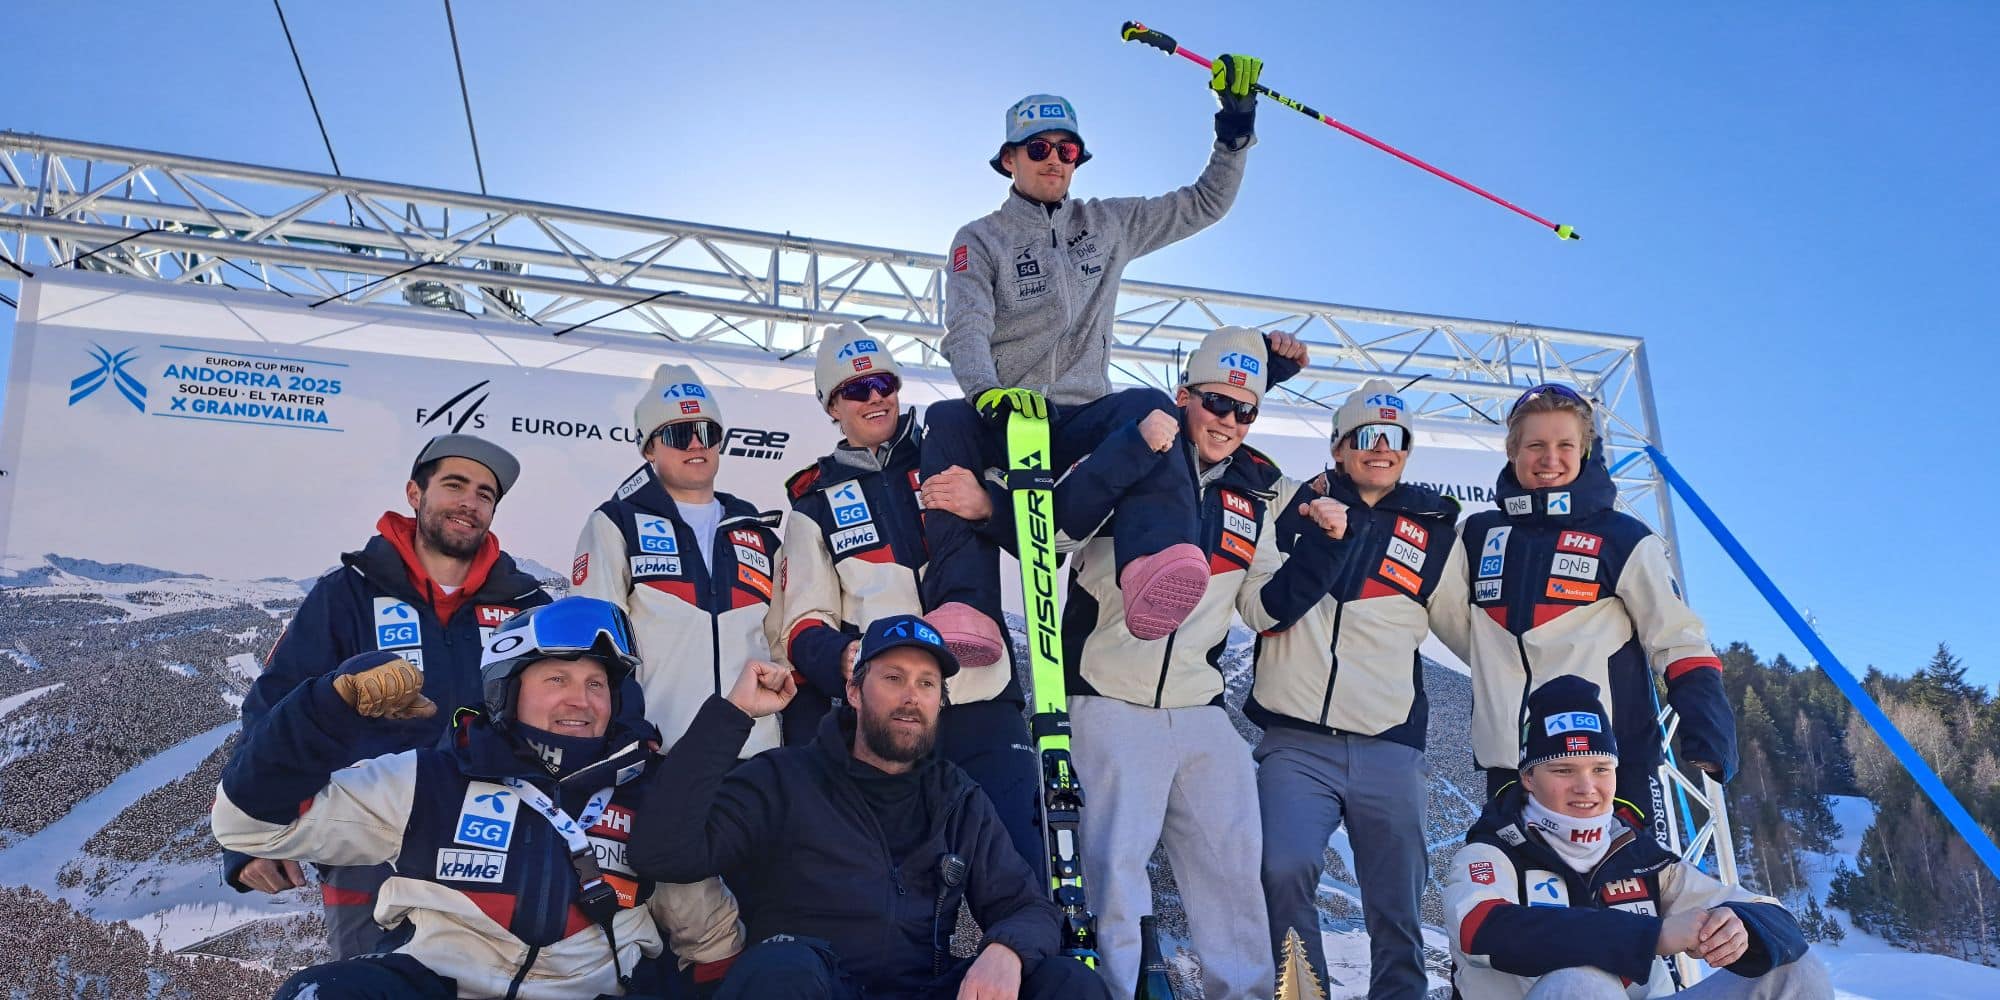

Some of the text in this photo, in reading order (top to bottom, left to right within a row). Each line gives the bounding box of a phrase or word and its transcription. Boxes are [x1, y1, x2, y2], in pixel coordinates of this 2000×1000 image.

[1042, 105, 1062, 116] 5G
[1076, 243, 1097, 258] DNB
[1020, 263, 1037, 274] 5G
[858, 341, 875, 351] 5G
[205, 357, 305, 374] EUROPA CUP MEN
[1242, 358, 1258, 372] 5G
[162, 364, 342, 394] ANDORRA 2025
[178, 383, 325, 407] SOLDEU EL TARTER
[685, 385, 702, 396] 5G
[192, 398, 329, 425] GRANDVALIRA
[511, 416, 638, 444] EUROPA CU
[719, 427, 790, 456] fae
[622, 475, 643, 495] DNB
[1225, 493, 1251, 513] HH
[1509, 497, 1527, 515] DNB
[840, 507, 864, 521] 5G
[1229, 516, 1252, 534] DNB
[1400, 520, 1425, 543] HH
[645, 538, 671, 551] 5G
[732, 530, 761, 547] HH
[836, 532, 875, 551] KPMG
[1563, 533, 1596, 550] HH
[741, 549, 766, 568] DNB
[1394, 543, 1419, 564] DNB
[634, 562, 678, 574] KPMG
[1483, 558, 1500, 572] 5G
[1559, 556, 1590, 575] DNB
[1027, 490, 1059, 665] FISCHER
[482, 607, 515, 622] HH
[383, 626, 413, 643] 5G
[917, 627, 939, 646] 5G
[1575, 716, 1596, 727] 5G
[597, 809, 631, 834] HH
[464, 821, 503, 842] 5G
[1570, 827, 1603, 843] HH
[439, 862, 499, 879] KPMG
[1604, 877, 1641, 896] HH
